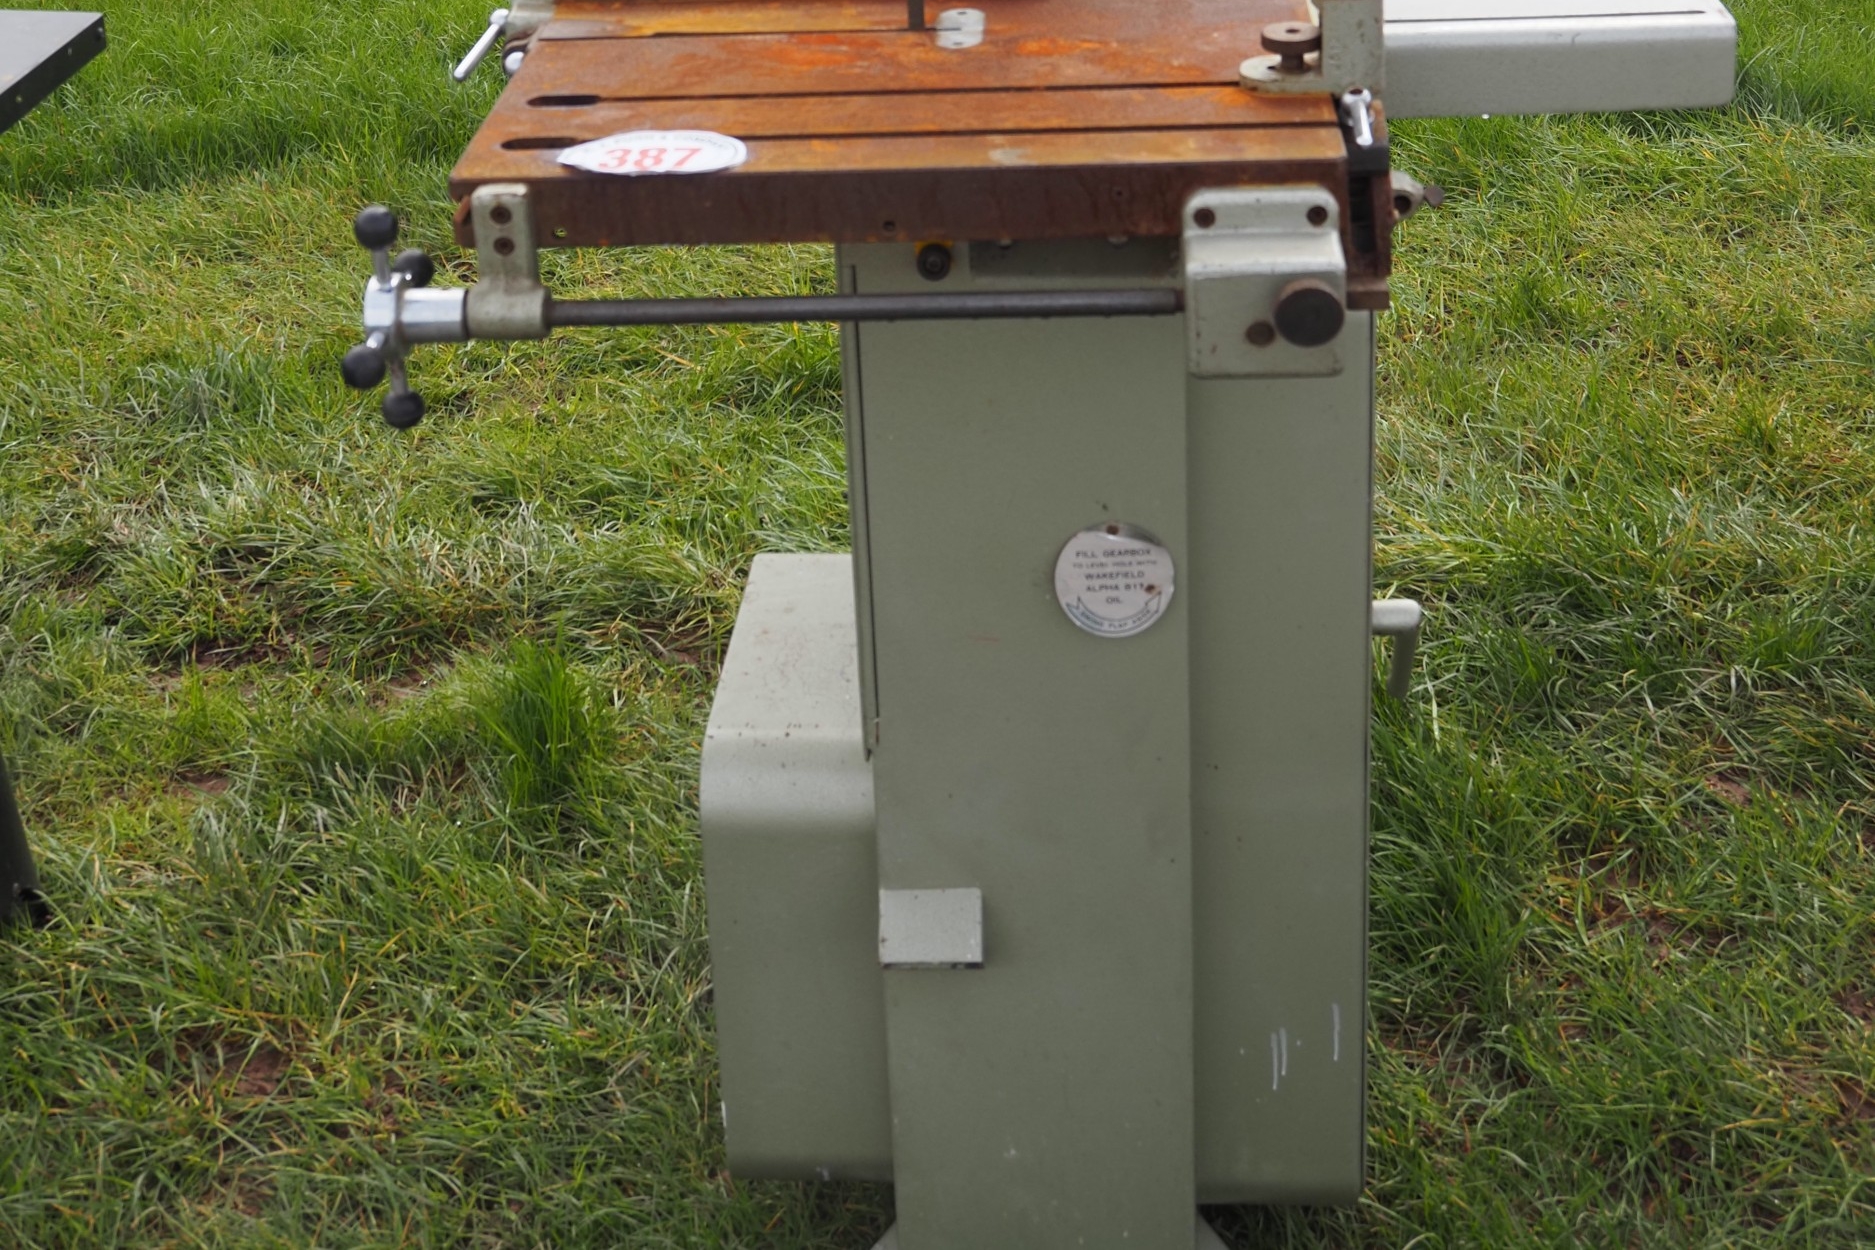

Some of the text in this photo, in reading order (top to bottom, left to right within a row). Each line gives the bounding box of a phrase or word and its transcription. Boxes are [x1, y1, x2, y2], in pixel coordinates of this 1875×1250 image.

[598, 147, 702, 171] 387
[1076, 548, 1151, 558] FILL GEARBOX
[1085, 571, 1144, 580] WAKEFIELD
[1086, 583, 1120, 592] ALPHA
